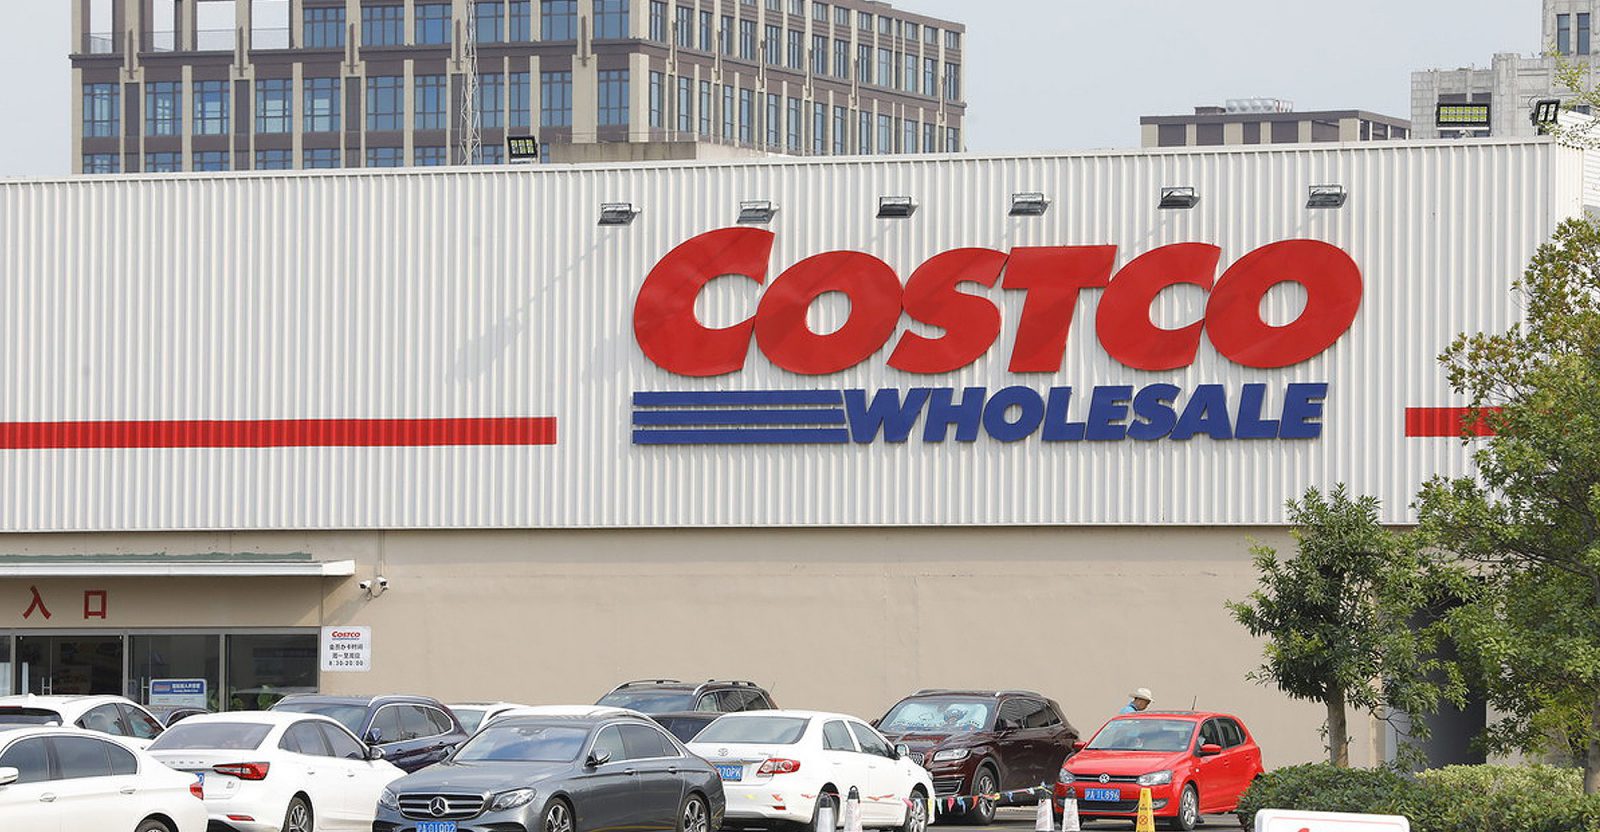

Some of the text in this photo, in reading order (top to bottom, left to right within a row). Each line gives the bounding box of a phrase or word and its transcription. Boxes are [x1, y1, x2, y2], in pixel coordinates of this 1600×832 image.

[633, 227, 1363, 377] COSTCO
[844, 383, 1328, 444] WHOLESALE
[23, 586, 107, 619] 入口
